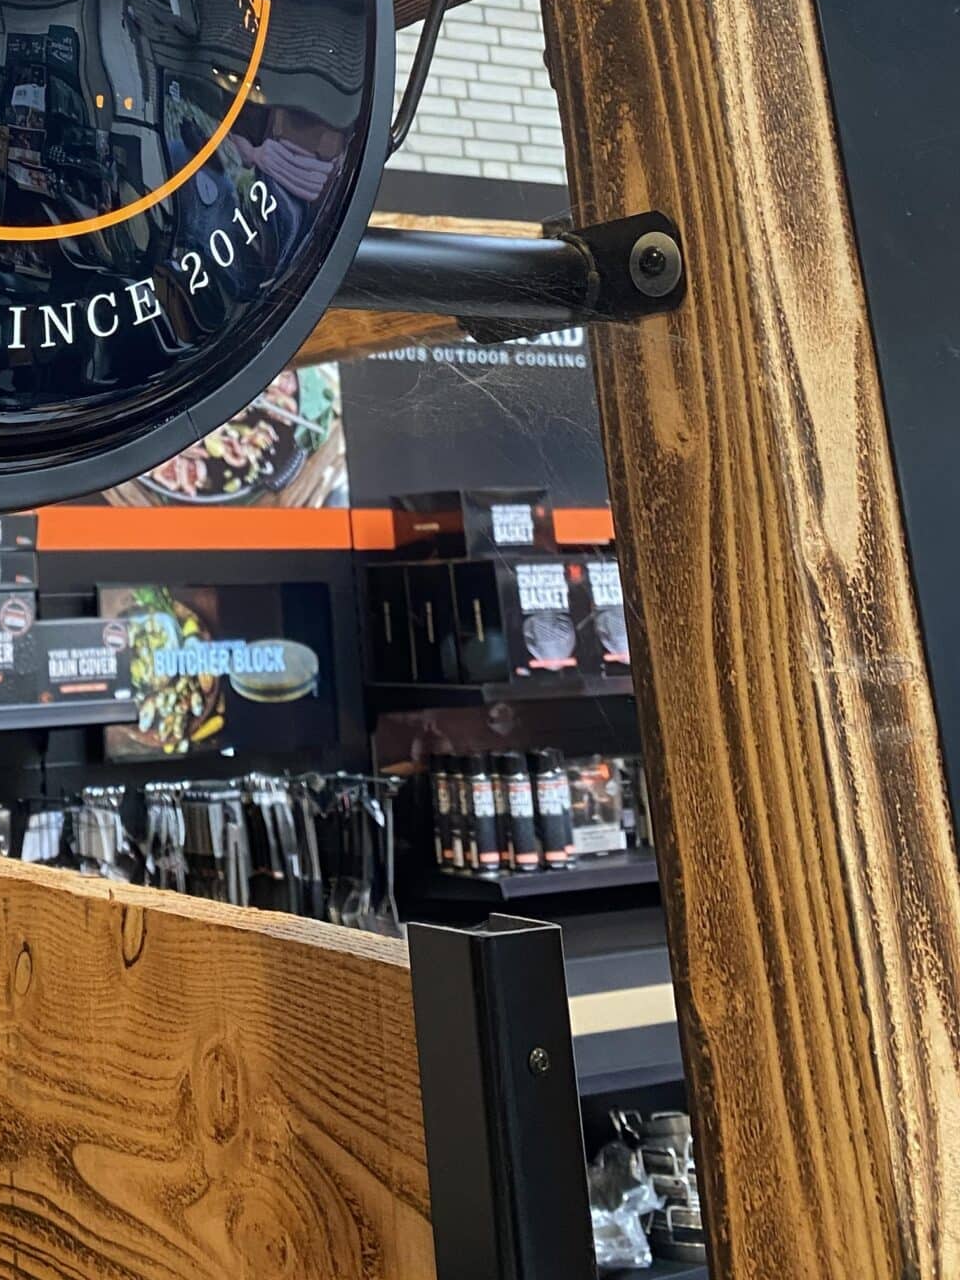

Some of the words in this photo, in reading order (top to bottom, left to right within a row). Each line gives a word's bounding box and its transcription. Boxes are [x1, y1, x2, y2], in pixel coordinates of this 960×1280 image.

[181, 179, 279, 297] 2012
[433, 347, 510, 365] OUTDOOR
[515, 352, 587, 369] COOKING
[48, 658, 78, 676] RAIN
[79, 657, 117, 675] COVER
[153, 646, 231, 678] BUTCHER
[232, 644, 287, 674] BLOCK
